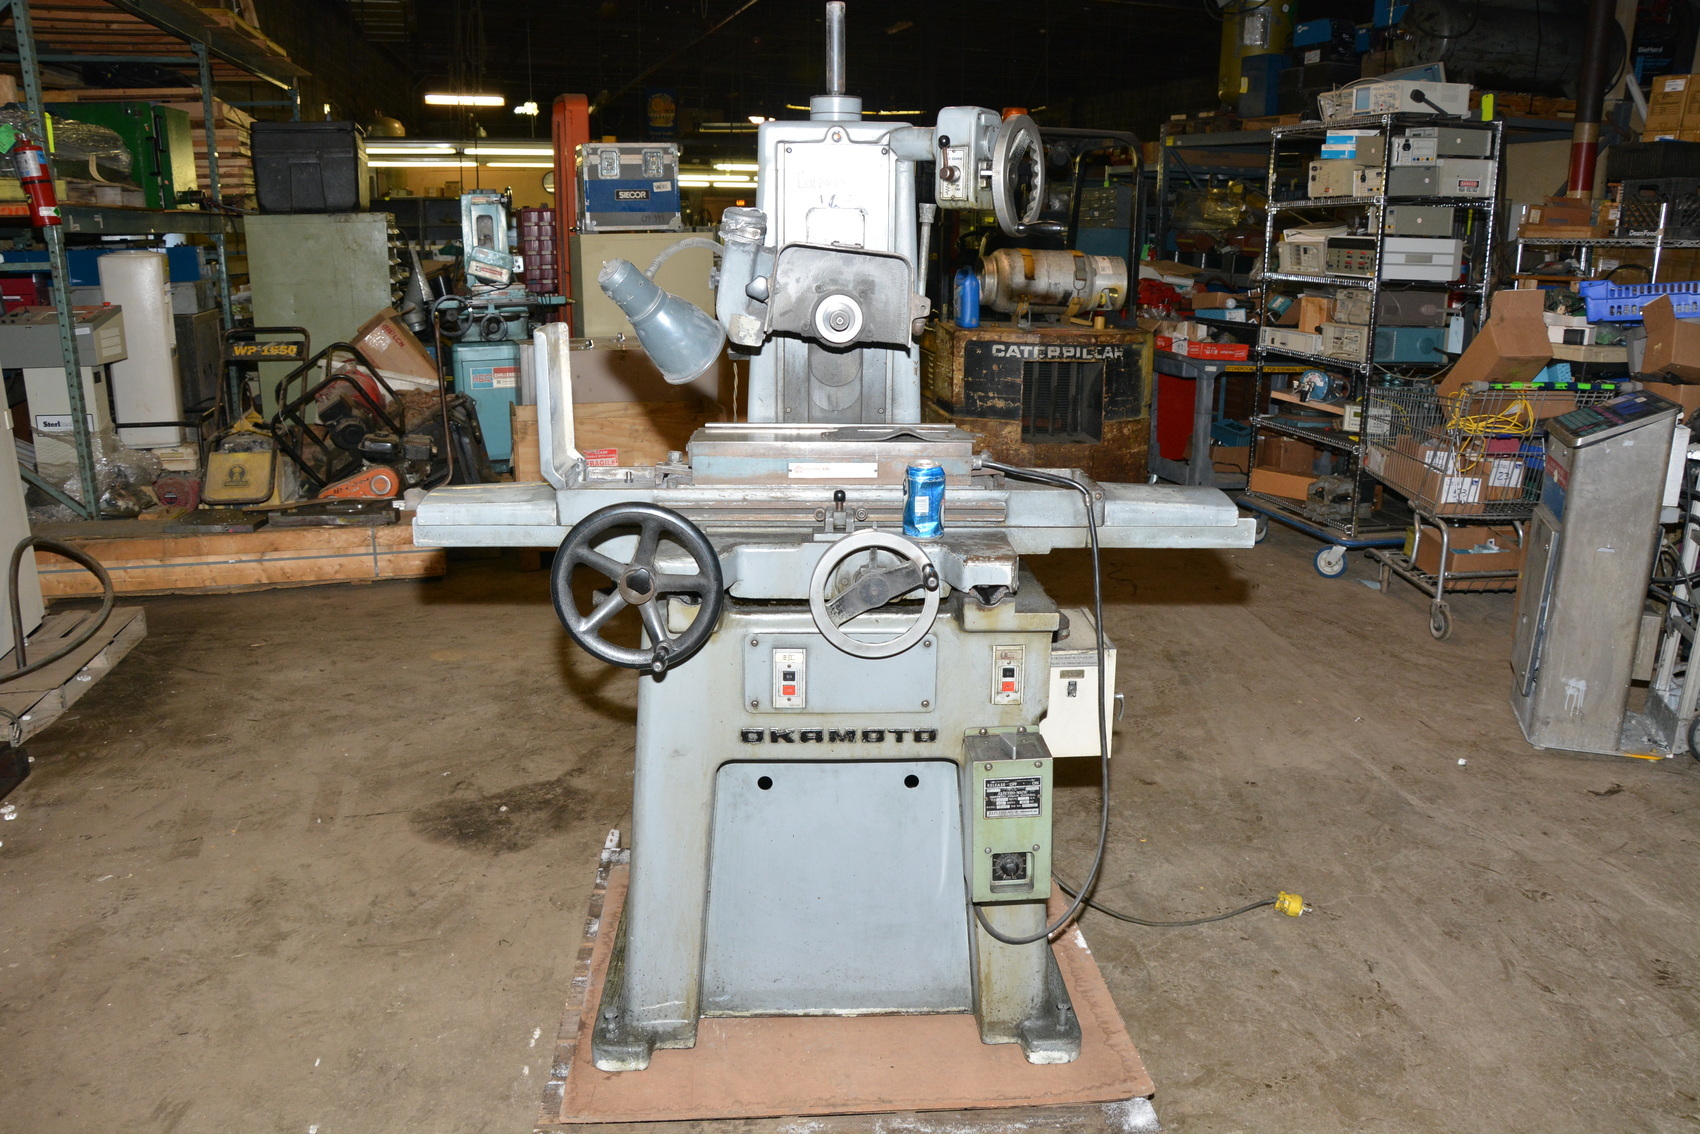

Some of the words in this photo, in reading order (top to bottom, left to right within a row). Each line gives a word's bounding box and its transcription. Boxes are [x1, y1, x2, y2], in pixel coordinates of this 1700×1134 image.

[619, 191, 647, 199] SIECOR
[233, 346, 257, 356] WP
[991, 344, 1124, 359] CATERPILLAR
[1497, 471, 1509, 481] 23
[740, 727, 938, 744] OKAMOTO
